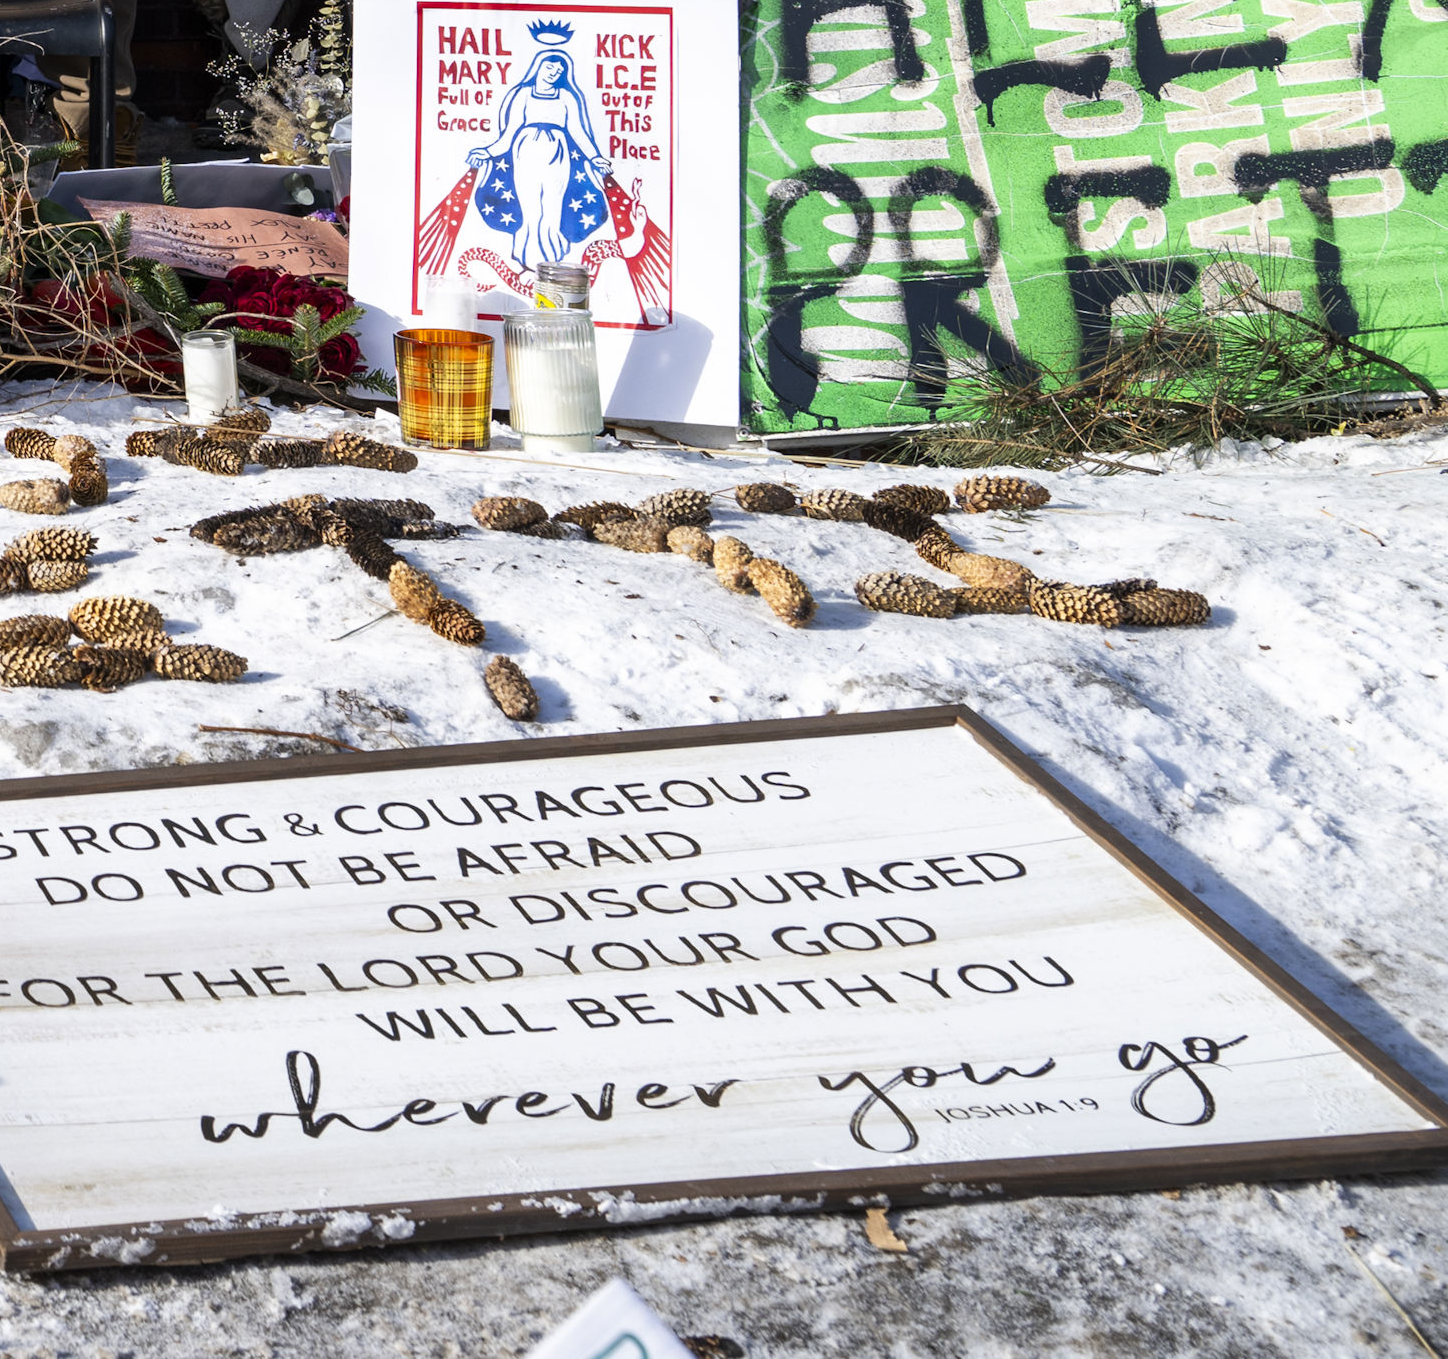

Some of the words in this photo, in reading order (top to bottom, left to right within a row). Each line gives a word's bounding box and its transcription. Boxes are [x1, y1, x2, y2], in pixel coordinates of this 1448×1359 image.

[438, 26, 512, 56] HAIL
[596, 33, 655, 60] KICK
[438, 60, 512, 85] MARY
[438, 87, 469, 106] Full
[437, 110, 491, 132] Grace
[605, 110, 652, 133] This
[609, 135, 661, 161] Place
[282, 809, 325, 839] &
[333, 769, 813, 839] COURAGEOUS
[34, 872, 145, 907] DO
[165, 859, 311, 900] NOT
[338, 850, 415, 887] BE
[454, 829, 705, 882] AFRAID
[386, 897, 502, 936] OR
[507, 851, 1029, 925] DISCOURAGED
[143, 962, 306, 1005] THE
[318, 948, 525, 992] LORD
[535, 930, 748, 980] YOUR
[771, 914, 941, 957] GOD
[355, 997, 558, 1043] WILL
[577, 990, 675, 1030] BE
[676, 969, 900, 1019] WITH
[900, 954, 1078, 999] YOU
[199, 1049, 751, 1145] wherever
[818, 1053, 1057, 1153] you
[1117, 1032, 1249, 1126] go
[932, 1097, 1056, 1128] JOSHUA
[1058, 1095, 1101, 1114] 1:9
